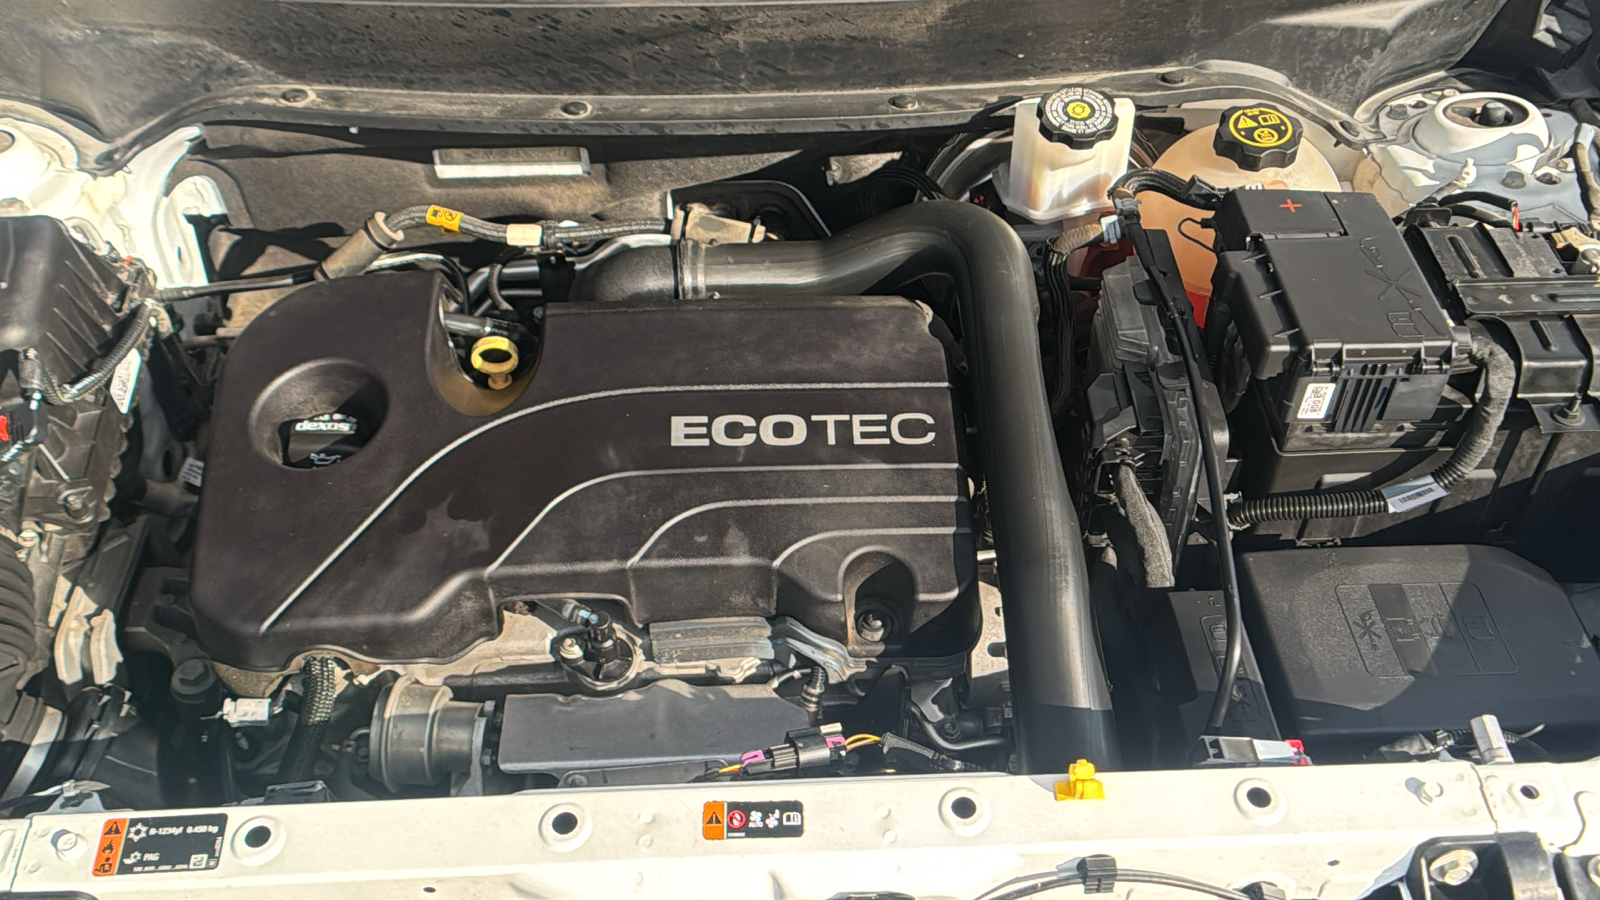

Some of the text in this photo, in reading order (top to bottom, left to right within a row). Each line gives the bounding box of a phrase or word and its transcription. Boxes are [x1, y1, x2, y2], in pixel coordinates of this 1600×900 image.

[670, 412, 936, 447] ECOTEC
[208, 825, 219, 834] kg
[143, 853, 160, 861] PAG
